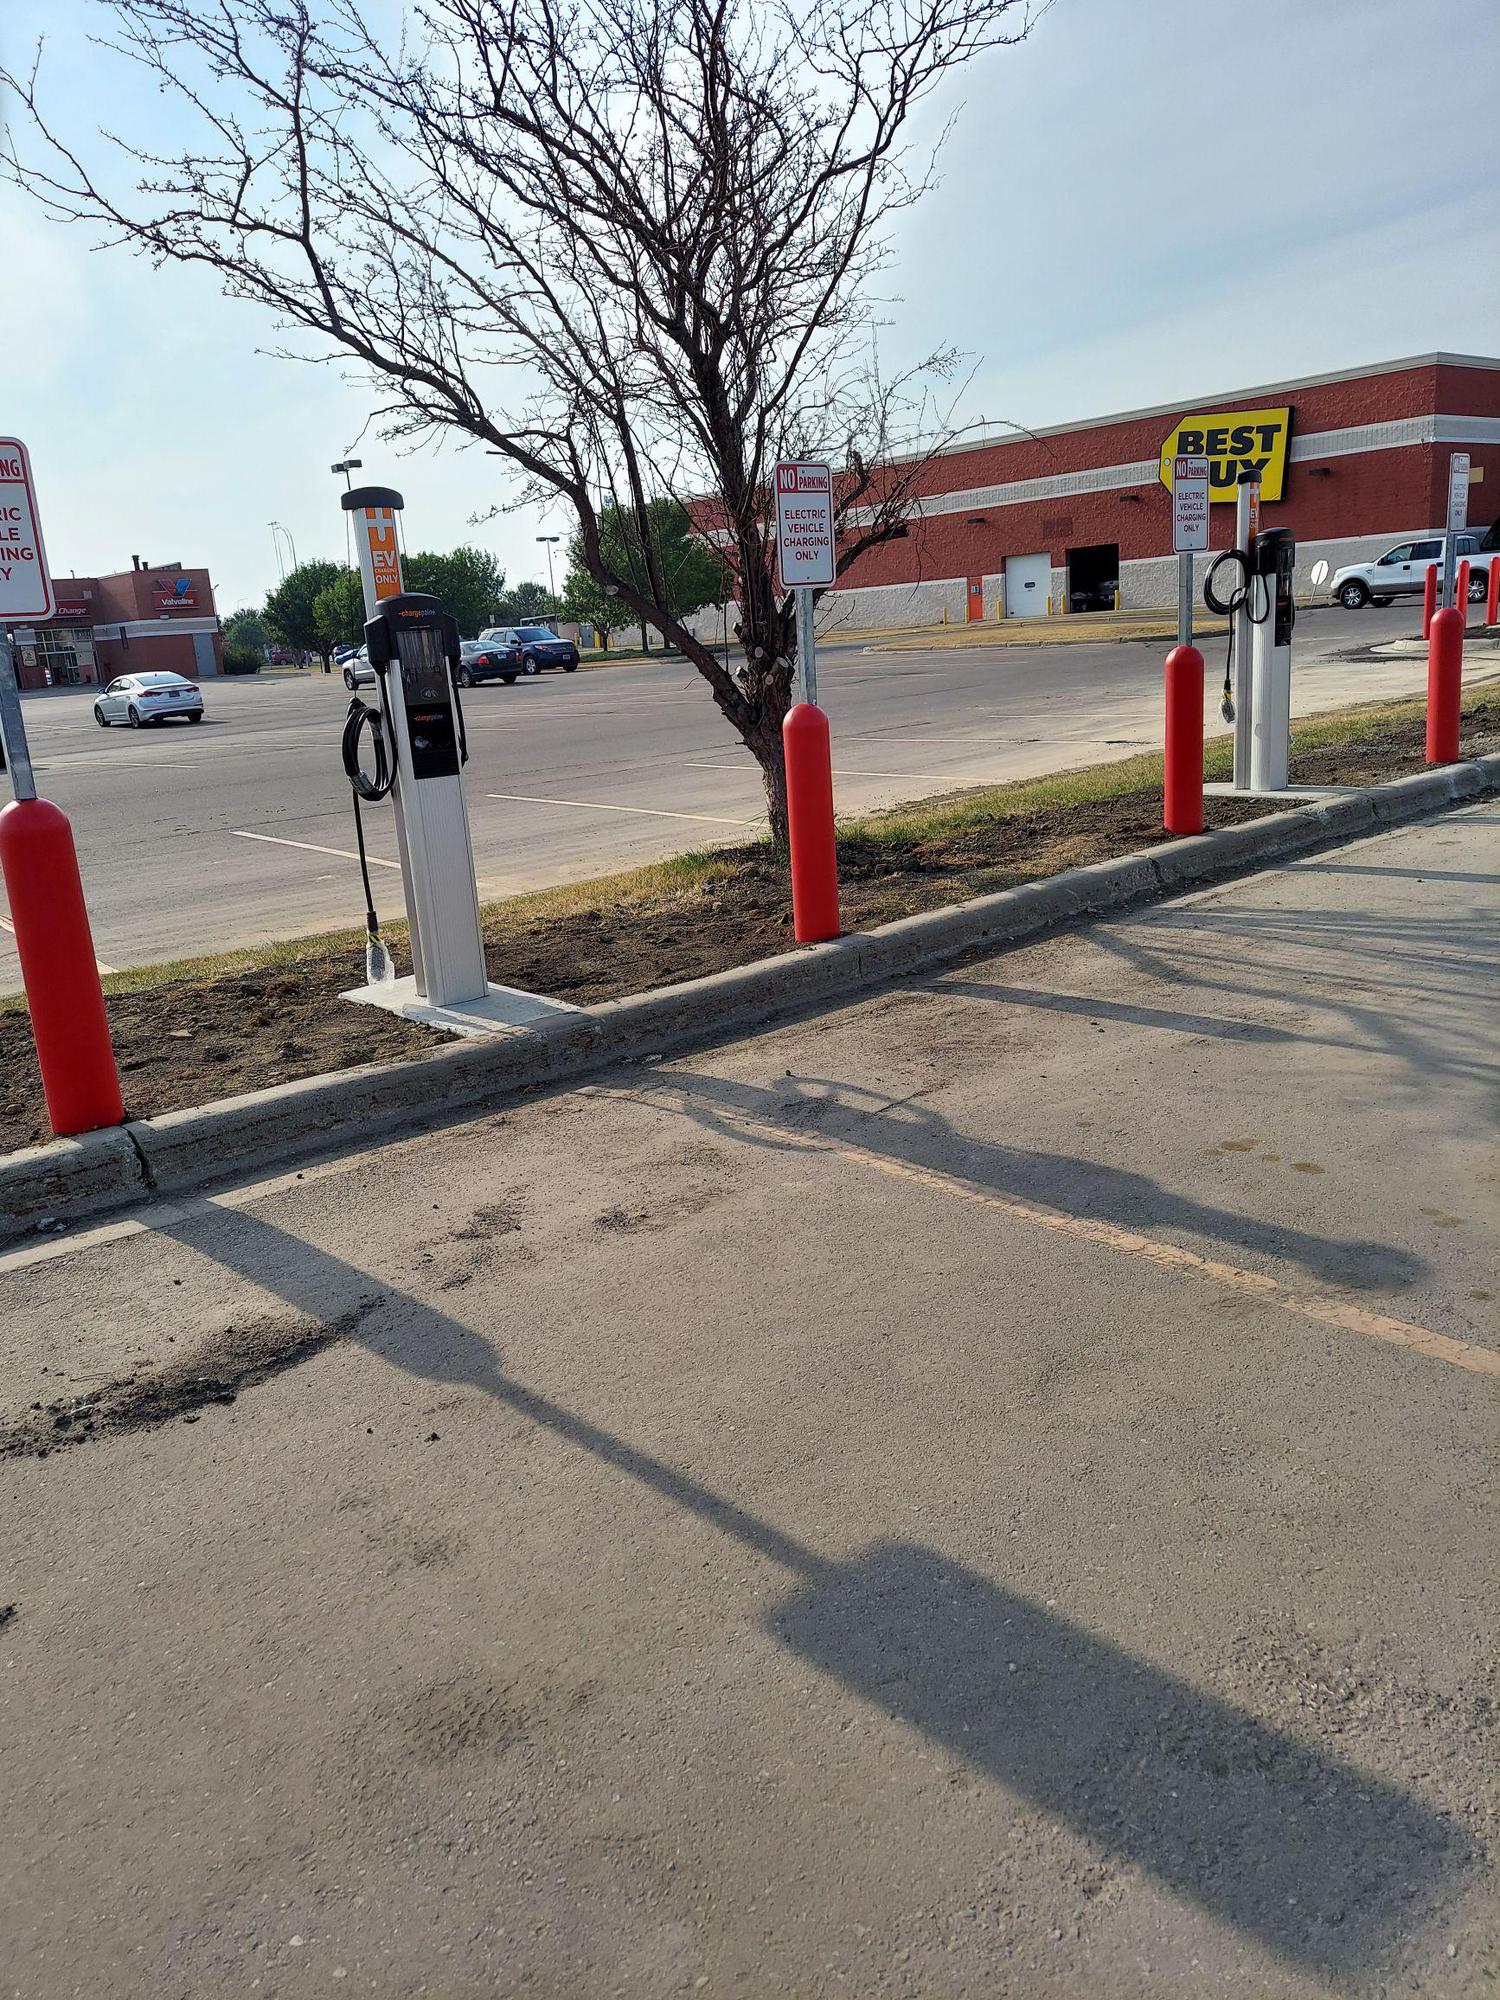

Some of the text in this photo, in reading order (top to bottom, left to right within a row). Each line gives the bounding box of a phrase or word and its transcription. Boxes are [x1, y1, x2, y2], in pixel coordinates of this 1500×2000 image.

[1177, 424, 1282, 456] BEST
[1176, 461, 1207, 477] NO PARKING
[1210, 458, 1271, 488] UY
[780, 469, 828, 490] NO PARKING
[1178, 492, 1205, 500] ELECTRIC
[1179, 502, 1203, 511] VEHICLE
[784, 509, 826, 520] ELECTRIC
[1176, 513, 1206, 522] CHARGING
[787, 523, 824, 533] VEHICLE
[1183, 524, 1200, 533] ONLY
[783, 537, 829, 547] CHARGING
[372, 550, 395, 567] EV
[795, 551, 819, 561] ONLY
[375, 574, 399, 584] ONLY
[58, 607, 87, 615] Change
